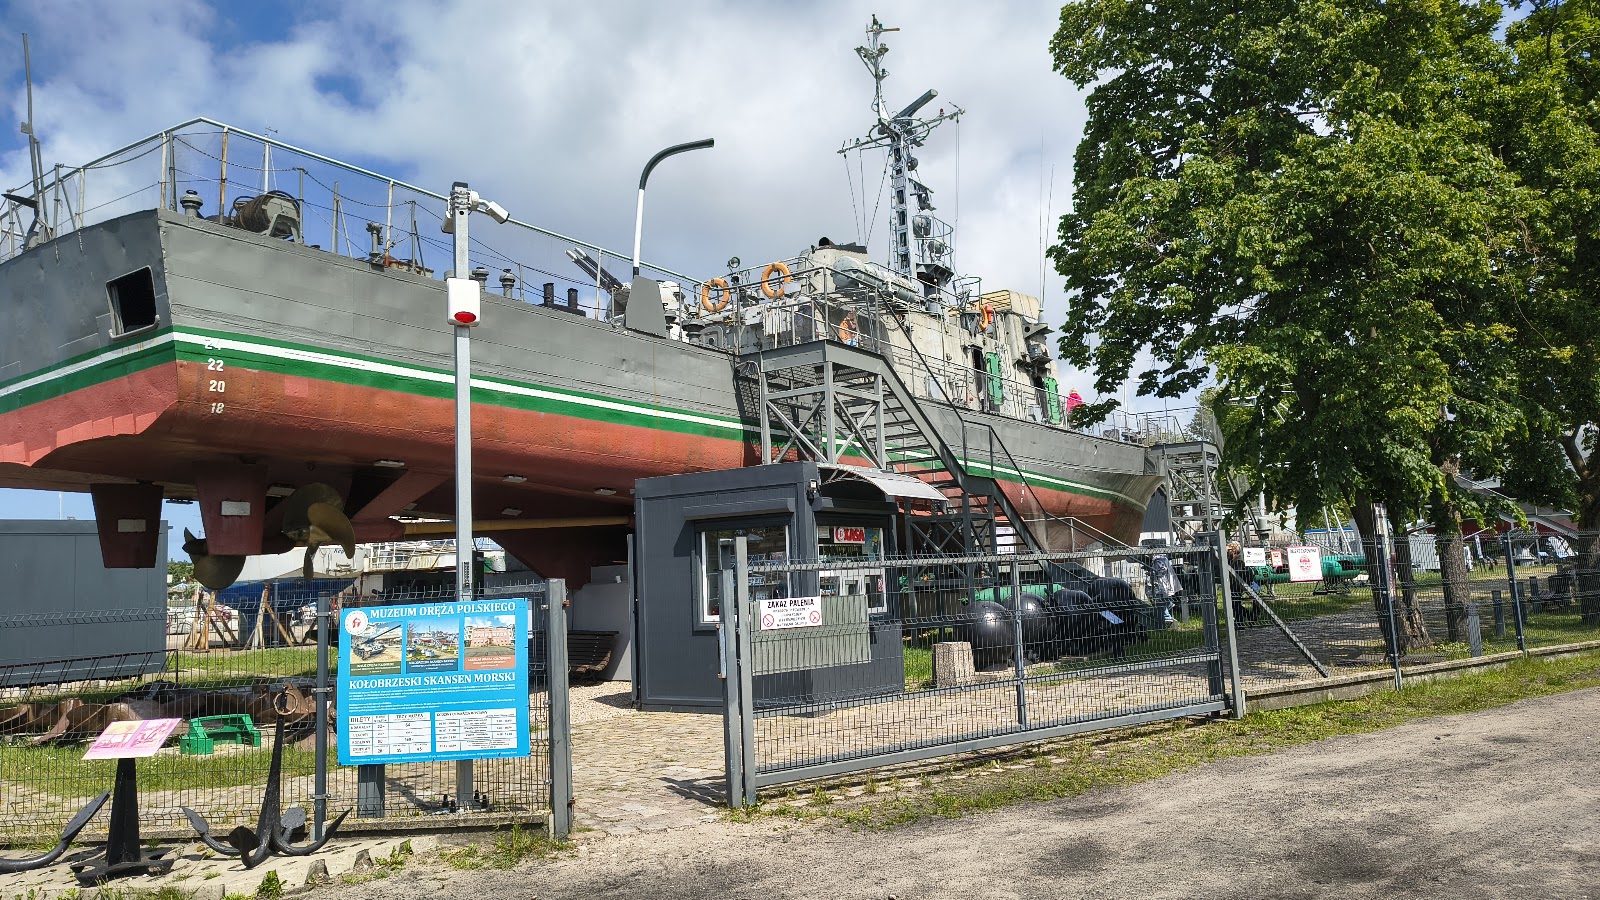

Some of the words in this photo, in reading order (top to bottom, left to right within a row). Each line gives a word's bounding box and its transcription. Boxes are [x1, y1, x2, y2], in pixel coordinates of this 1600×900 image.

[208, 358, 224, 371] 22
[209, 380, 225, 392] 20
[210, 402, 225, 414] 18
[844, 527, 865, 542] KASA
[370, 608, 420, 618] MUZEUM
[421, 604, 454, 618] ORĘŻA
[457, 602, 515, 613] POLSKIEGO
[767, 600, 787, 609] ZAKAZ
[789, 598, 815, 607] PALENIA
[349, 676, 421, 689] KOŁOBRZESKI
[424, 674, 472, 686] SKANSEN
[475, 672, 515, 683] MORSKI
